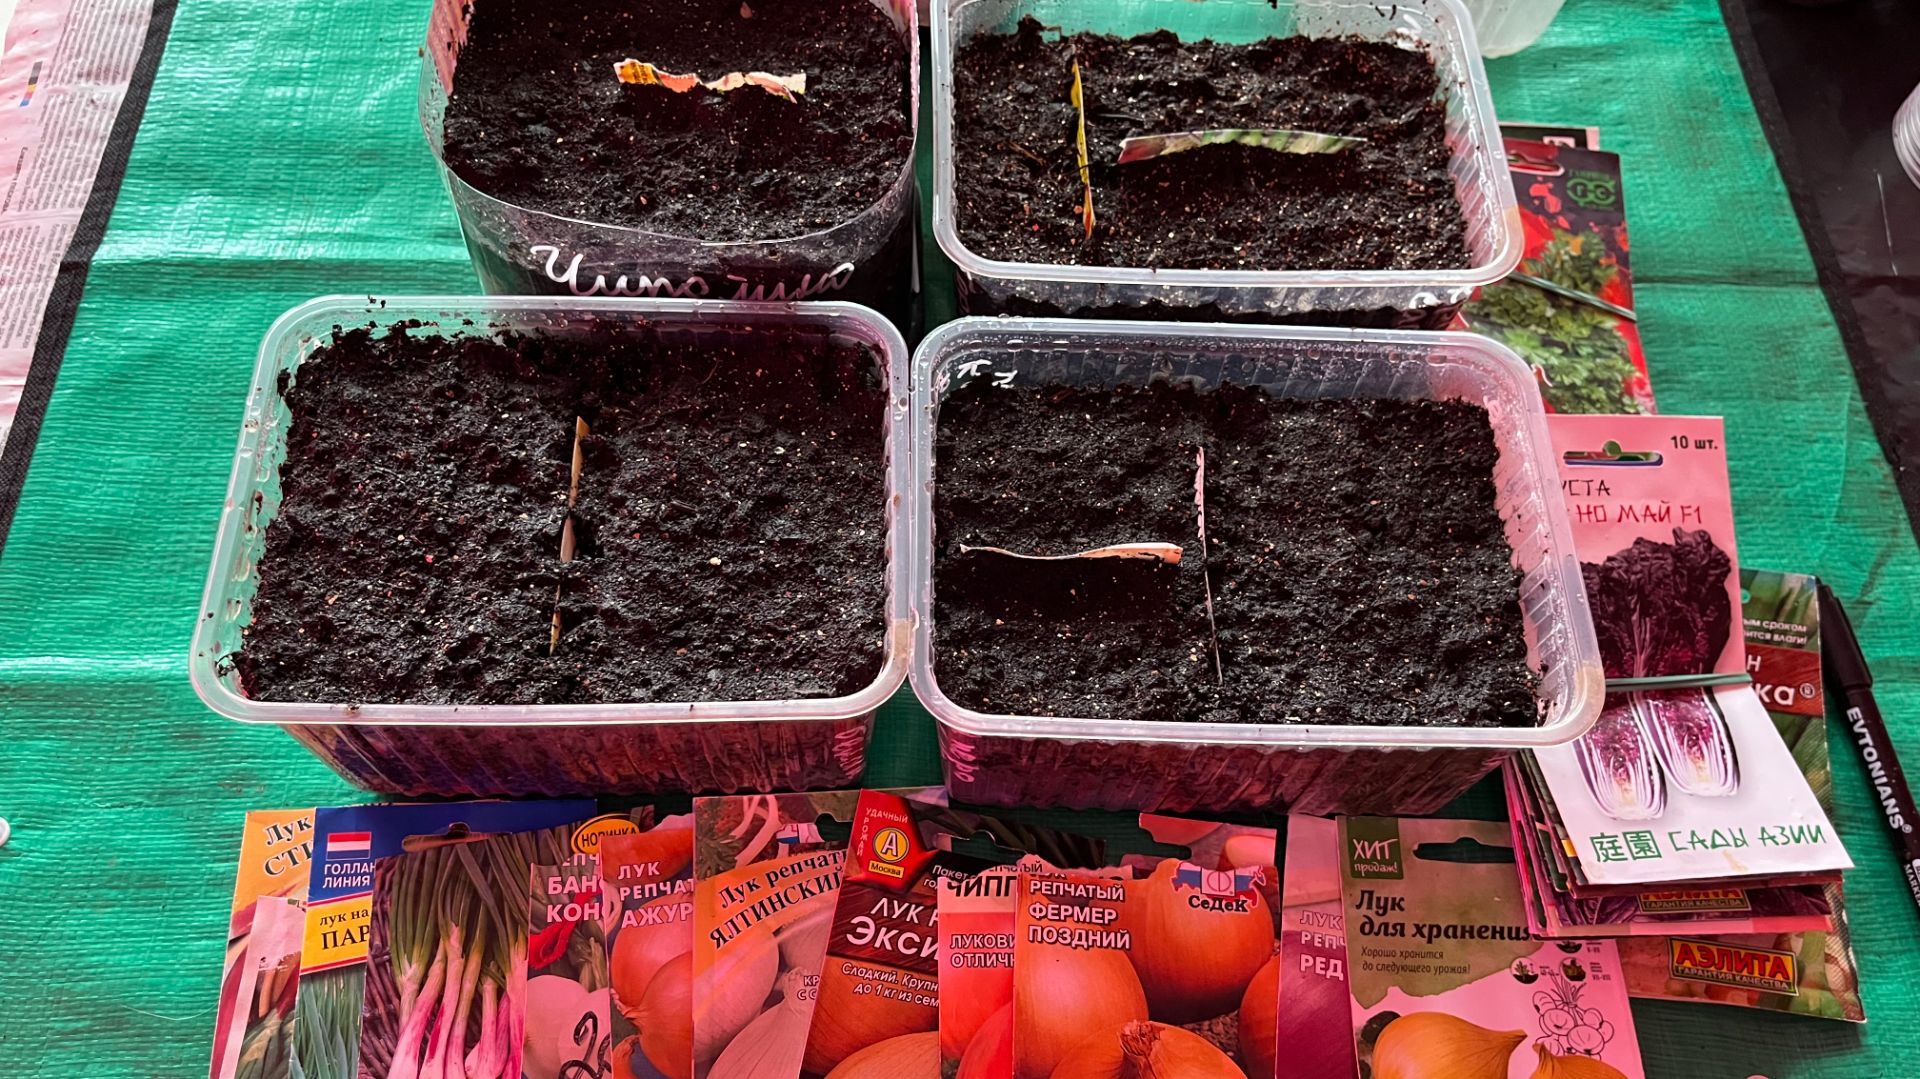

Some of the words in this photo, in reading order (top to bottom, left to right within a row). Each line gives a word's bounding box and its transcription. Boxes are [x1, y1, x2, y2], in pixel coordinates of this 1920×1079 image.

[1671, 435, 1689, 449] 10
[1695, 439, 1718, 450] шт.
[1617, 500, 1671, 523] МАЙ
[1681, 505, 1702, 524] F1
[866, 807, 909, 824] УДАЧНЫЙ
[264, 816, 312, 846] Лук
[1590, 830, 1662, 862] 庭園
[1667, 827, 1749, 851] САДЫ
[1757, 823, 1826, 846] АЗИИ
[1353, 838, 1399, 861] ХИТ
[618, 861, 660, 880] ЛУК
[871, 862, 902, 876] Москва
[932, 864, 969, 880] Пакет
[1354, 861, 1398, 877] продаж!
[322, 875, 371, 889] ЛИНИЯ
[719, 877, 761, 909] Лук
[1030, 880, 1124, 901] РЕПЧАТЫЙ
[870, 897, 924, 924] ЛУК
[1029, 902, 1118, 925] ФЕРМЕР
[1355, 890, 1405, 916] Лук
[320, 911, 347, 928] лук
[351, 907, 369, 922] на
[621, 902, 693, 929] АЖУР
[1300, 910, 1343, 930] ЛУК
[1359, 915, 1406, 938] для
[322, 923, 370, 950] ПАР
[1029, 925, 1131, 951] ПОЗДНИЙ
[1361, 946, 1397, 960] Хорошо
[1399, 949, 1444, 960] хранится
[1676, 944, 1790, 981] АЭЛИТА
[842, 963, 898, 984] Сладкий.
[1300, 954, 1344, 981] РЕД
[1362, 961, 1374, 971] до
[1375, 962, 1431, 974] следующего
[1433, 964, 1471, 976] урожая!
[1678, 966, 1733, 980] ГАРАНТИЯ
[1735, 974, 1788, 990] КАЧЕСТВА
[876, 984, 883, 995] 1
[884, 988, 897, 998] кг
[898, 990, 912, 1002] из
